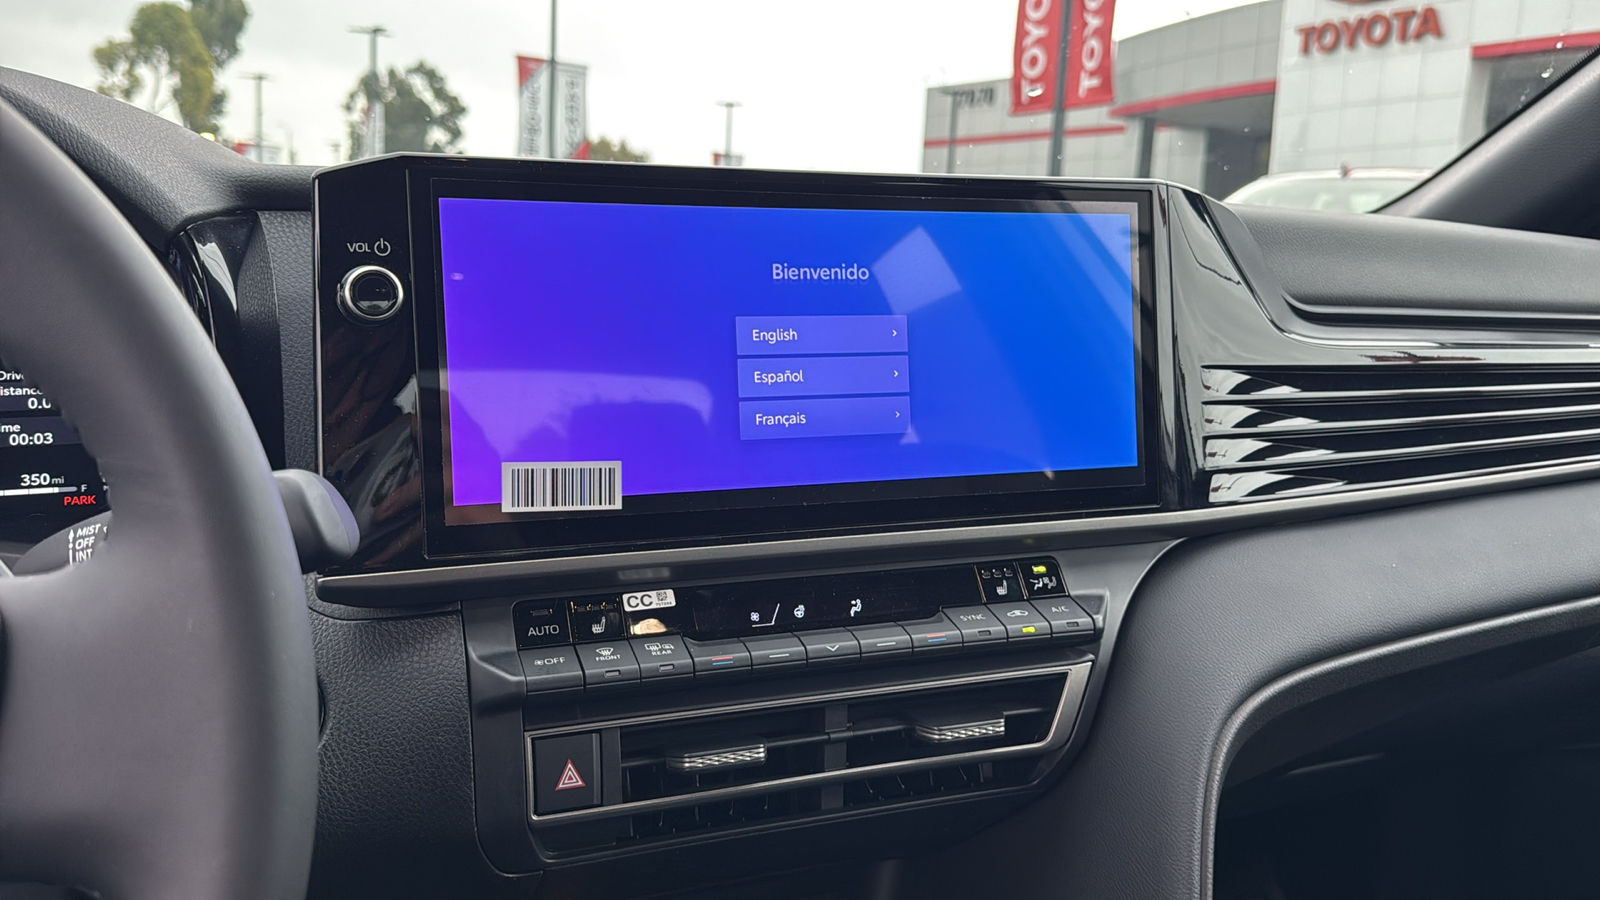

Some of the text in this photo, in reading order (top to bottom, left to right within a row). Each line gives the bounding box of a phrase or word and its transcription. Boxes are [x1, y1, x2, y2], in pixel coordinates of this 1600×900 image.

[1297, 6, 1442, 57] TOYOTA
[346, 242, 371, 253] VOL
[772, 262, 870, 280] Bienvenido
[752, 328, 798, 344] English
[753, 369, 804, 385] Español
[755, 412, 807, 427] Français
[9, 432, 54, 446] 00:03
[20, 472, 65, 487] 350 mi
[81, 484, 88, 493] F
[63, 494, 97, 507] PARK
[76, 523, 101, 538] MIST
[75, 536, 95, 550] OFF
[75, 548, 93, 562] INT
[626, 593, 653, 609] CC
[1051, 605, 1069, 613] A/C
[960, 613, 986, 621] SYNC
[527, 624, 560, 637] AUTO
[544, 656, 566, 666] OFF
[595, 654, 621, 662] FRONT
